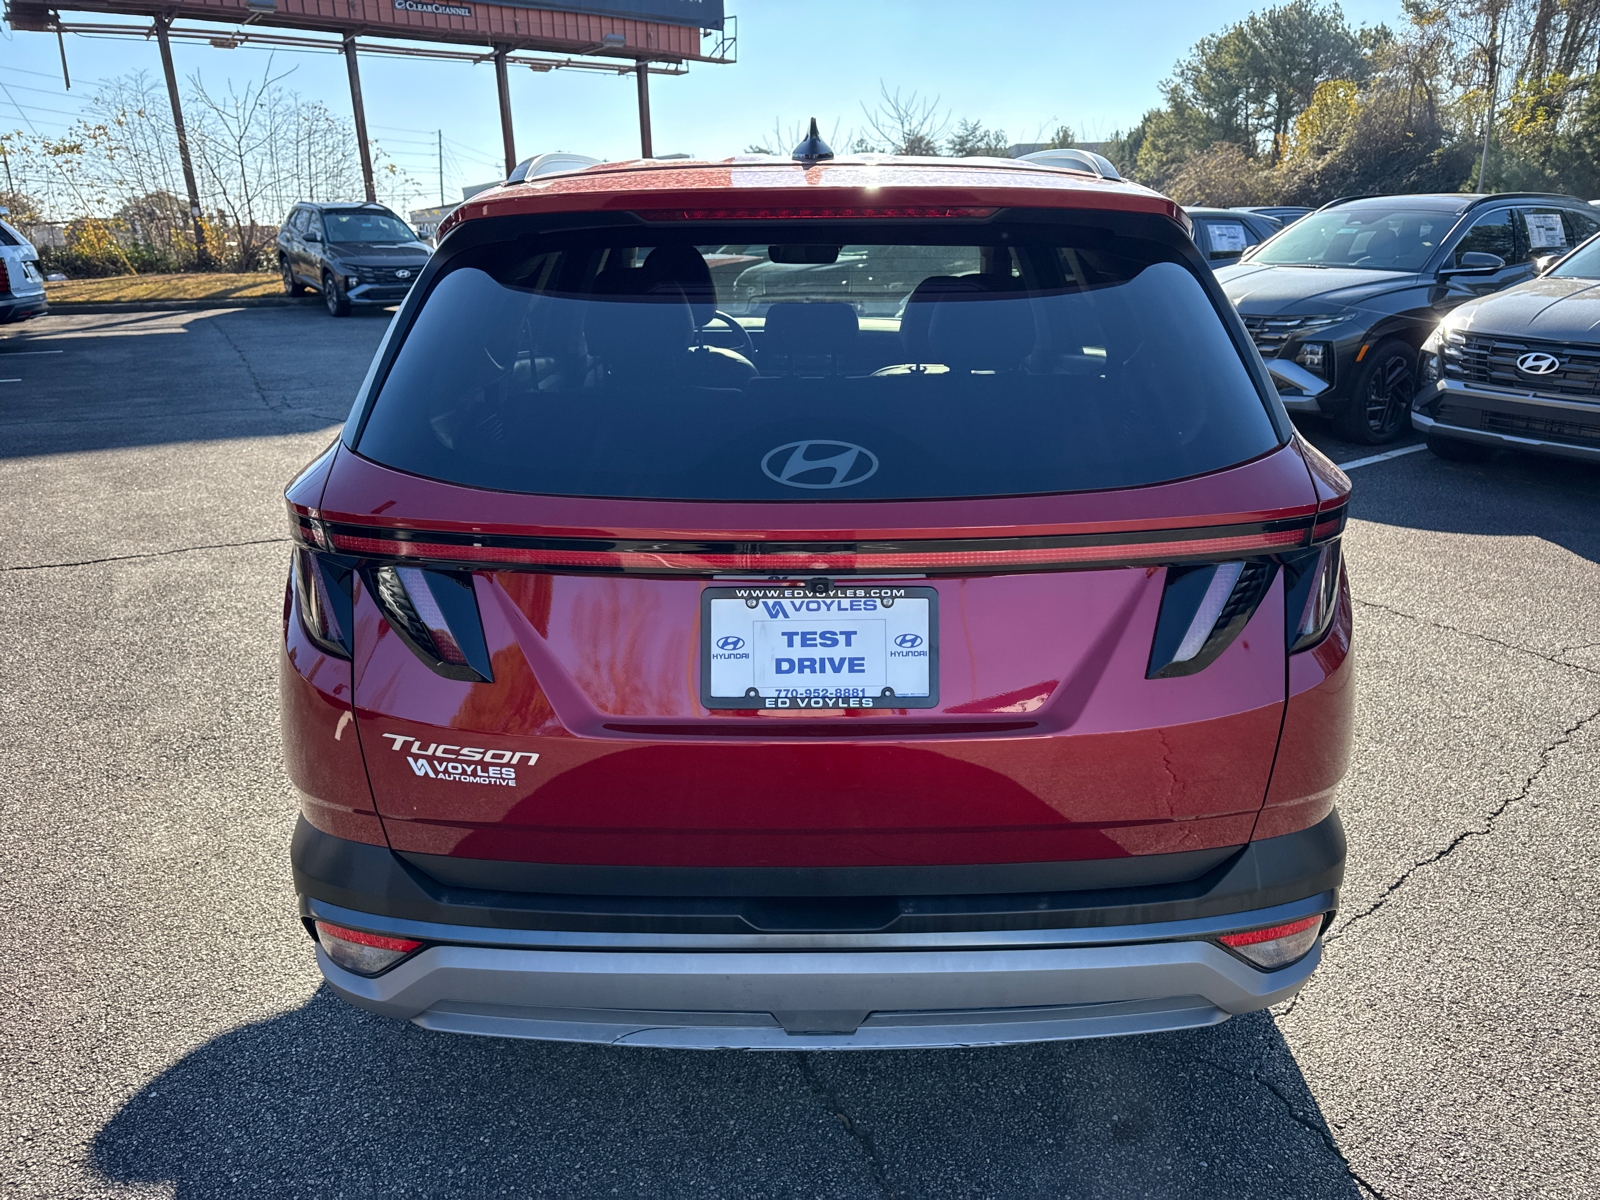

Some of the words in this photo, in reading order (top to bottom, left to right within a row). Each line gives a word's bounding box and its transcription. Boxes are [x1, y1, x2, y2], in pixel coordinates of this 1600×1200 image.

[790, 599, 878, 612] VOYLES
[781, 630, 858, 648] TEST
[712, 652, 750, 660] HYUNDAI
[890, 650, 928, 658] HYUNDAI
[775, 656, 866, 675] DRIVE
[775, 688, 866, 698] 770-952-8881
[765, 698, 790, 708] ED
[797, 697, 874, 708] VOYLES
[433, 760, 516, 779] VOYLES
[437, 772, 517, 787] AUTOMOTIVE
